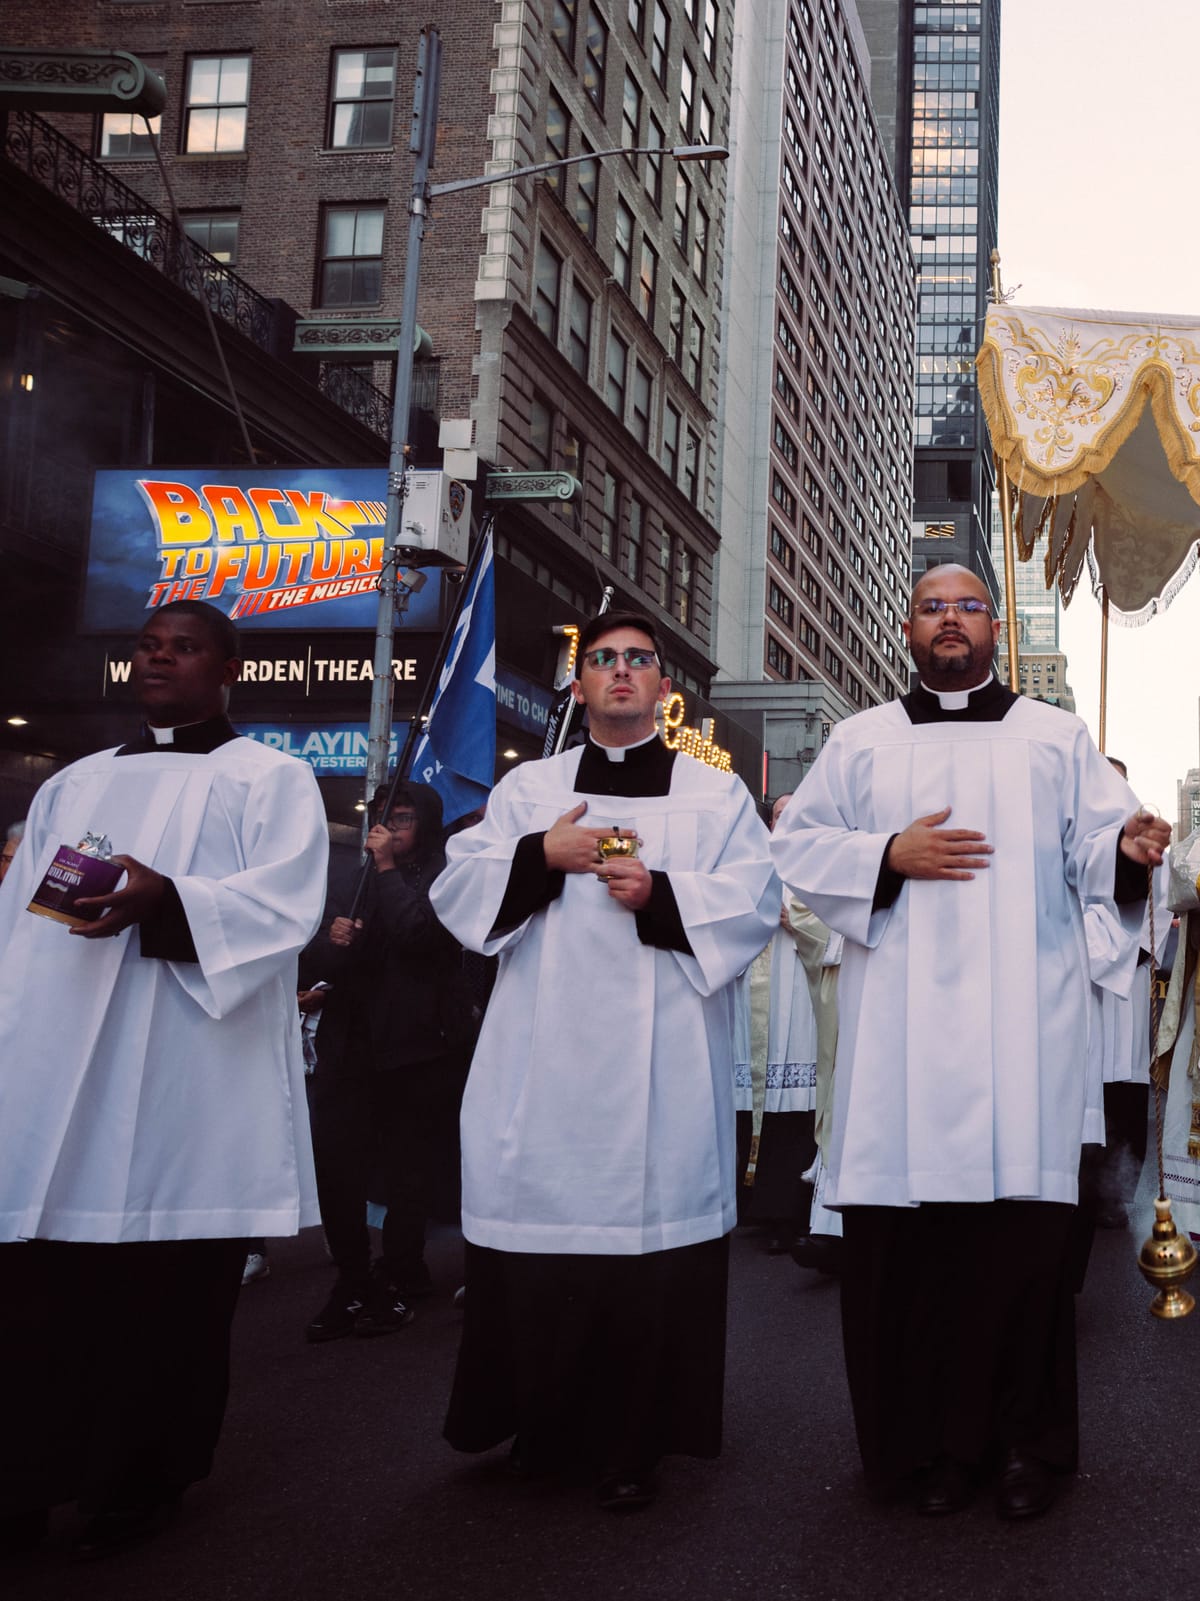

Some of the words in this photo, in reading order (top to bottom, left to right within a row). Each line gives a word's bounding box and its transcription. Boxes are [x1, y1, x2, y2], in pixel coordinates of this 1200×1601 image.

[137, 480, 355, 546] BACK
[160, 549, 212, 579] TO
[148, 578, 207, 608] THE
[268, 587, 308, 608] THE
[310, 575, 381, 601] MUSICA
[233, 660, 304, 682] RDEN
[314, 659, 417, 682] THEARE
[517, 693, 530, 716] TO
[531, 702, 549, 725] CHA
[312, 757, 397, 768] YESTERY!
